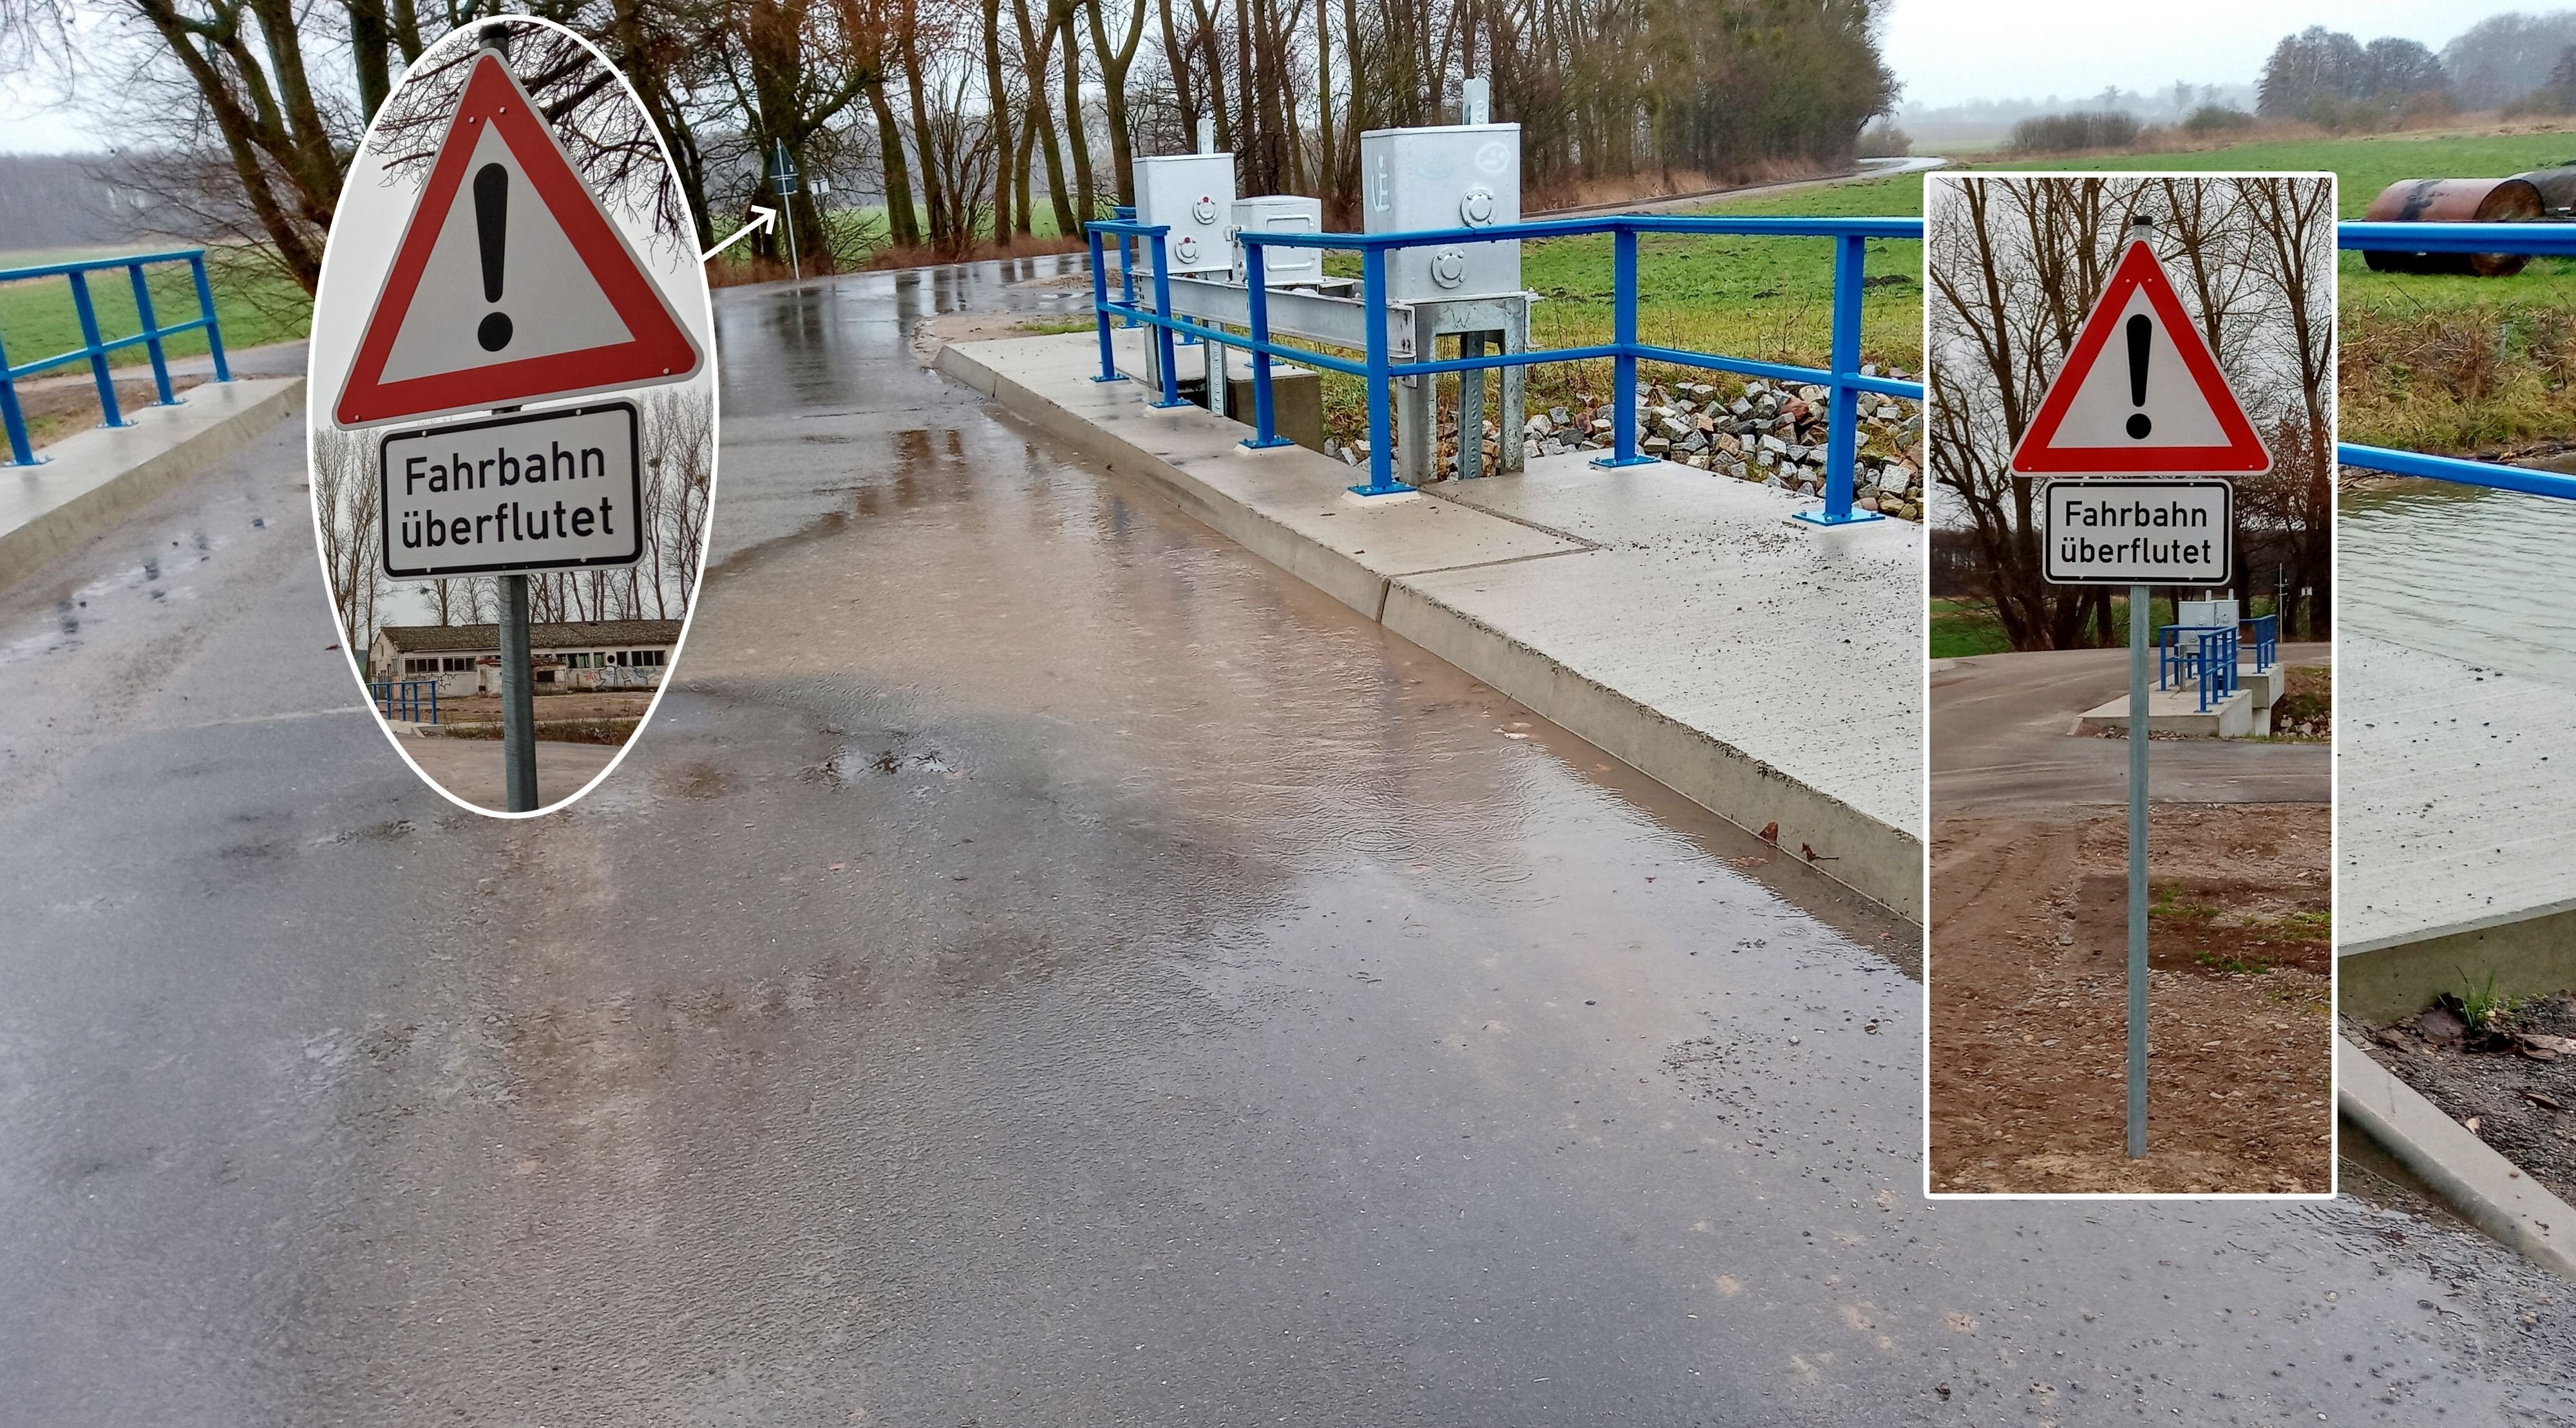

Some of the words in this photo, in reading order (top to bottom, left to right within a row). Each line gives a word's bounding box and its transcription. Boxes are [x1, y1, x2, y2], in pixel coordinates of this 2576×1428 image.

[406, 441, 605, 495] Fahrbahn
[402, 496, 614, 548] überflutet
[2065, 500, 2207, 527] Fahrbahn
[2061, 536, 2211, 564] überflutet
